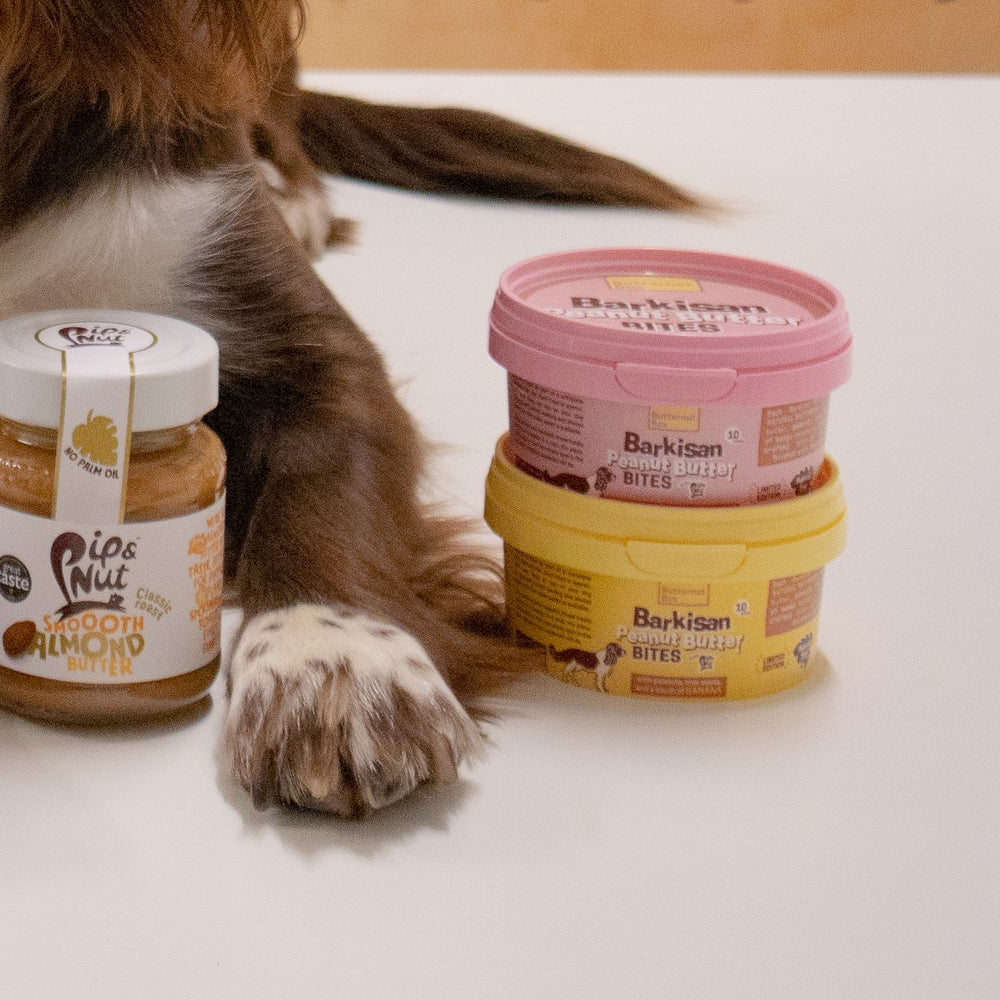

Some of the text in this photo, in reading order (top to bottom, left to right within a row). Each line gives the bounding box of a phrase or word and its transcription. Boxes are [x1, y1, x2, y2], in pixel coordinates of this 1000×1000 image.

[571, 296, 768, 314] Barkisan
[675, 310, 804, 327] Butter
[624, 431, 722, 458] Barkisan
[63, 447, 119, 479] NO PALM OIL
[607, 449, 737, 483] Peanut Butter
[623, 472, 672, 489] BITES
[71, 564, 129, 599] Nut
[135, 601, 164, 620] roast
[633, 606, 731, 632] Barkisan
[29, 632, 145, 660] ALMOND
[616, 625, 744, 654] Peanut Butter
[67, 655, 133, 677] BUTTER
[632, 646, 681, 663] BITES
